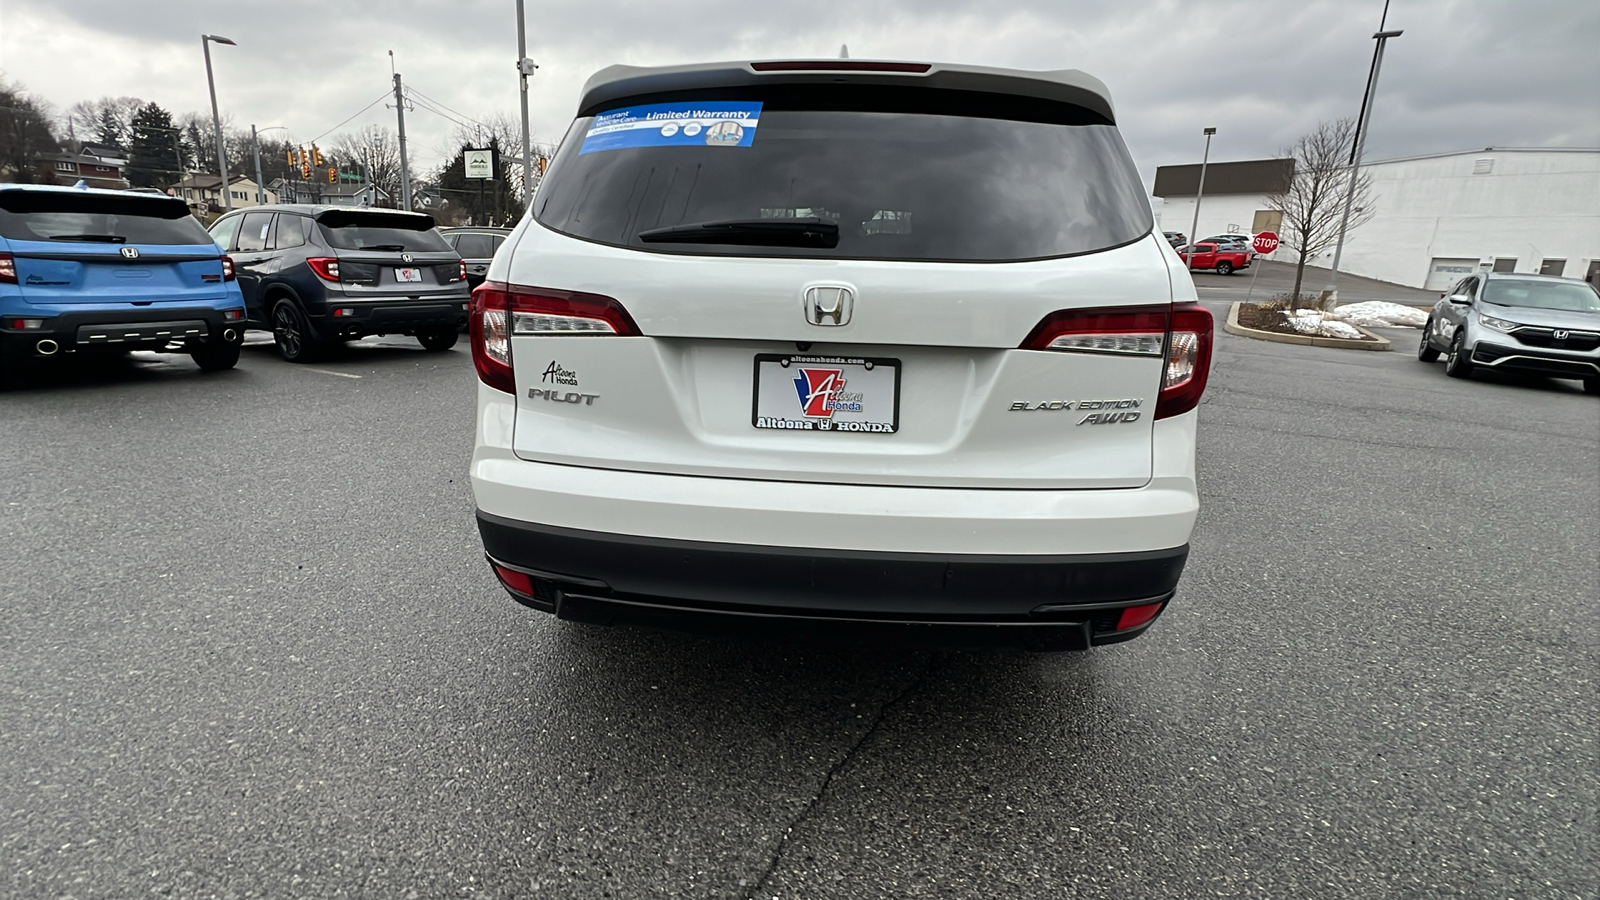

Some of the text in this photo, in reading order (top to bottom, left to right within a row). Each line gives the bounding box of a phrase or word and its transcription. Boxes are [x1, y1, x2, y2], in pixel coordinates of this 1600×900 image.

[645, 110, 750, 120] Limited Warranty
[1254, 237, 1278, 249] STOP
[790, 356, 865, 365] altoonahonda.com
[556, 376, 578, 386] Honda
[528, 388, 600, 406] PILOT
[827, 400, 862, 411] Honda
[1008, 398, 1143, 411] BLACK EDITION
[1076, 410, 1141, 426] AWD
[757, 417, 813, 430] Altoona
[837, 421, 894, 432] HONDA
